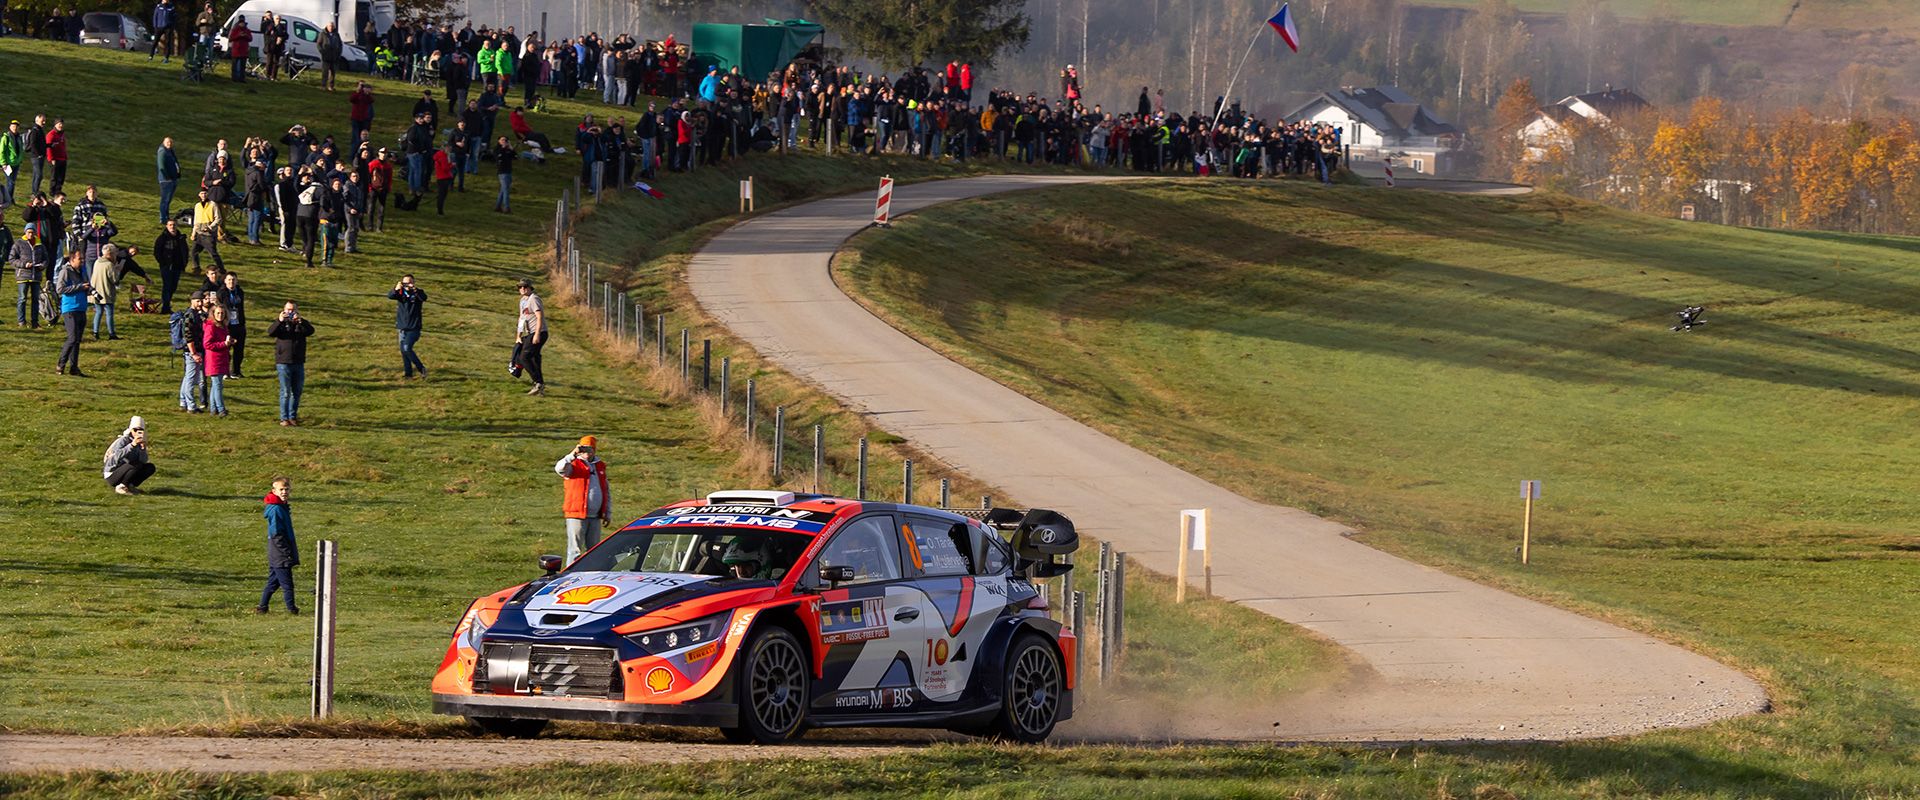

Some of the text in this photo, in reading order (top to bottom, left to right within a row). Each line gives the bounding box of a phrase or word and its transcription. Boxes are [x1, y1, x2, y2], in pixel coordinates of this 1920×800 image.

[699, 506, 771, 515] HYUNDAI
[673, 515, 799, 529] FORUM8
[901, 523, 923, 569] 8
[875, 629, 887, 638] FUEL
[688, 644, 717, 662] PIRELLI
[927, 638, 949, 667] 10
[835, 696, 869, 707] HYUNDAI
